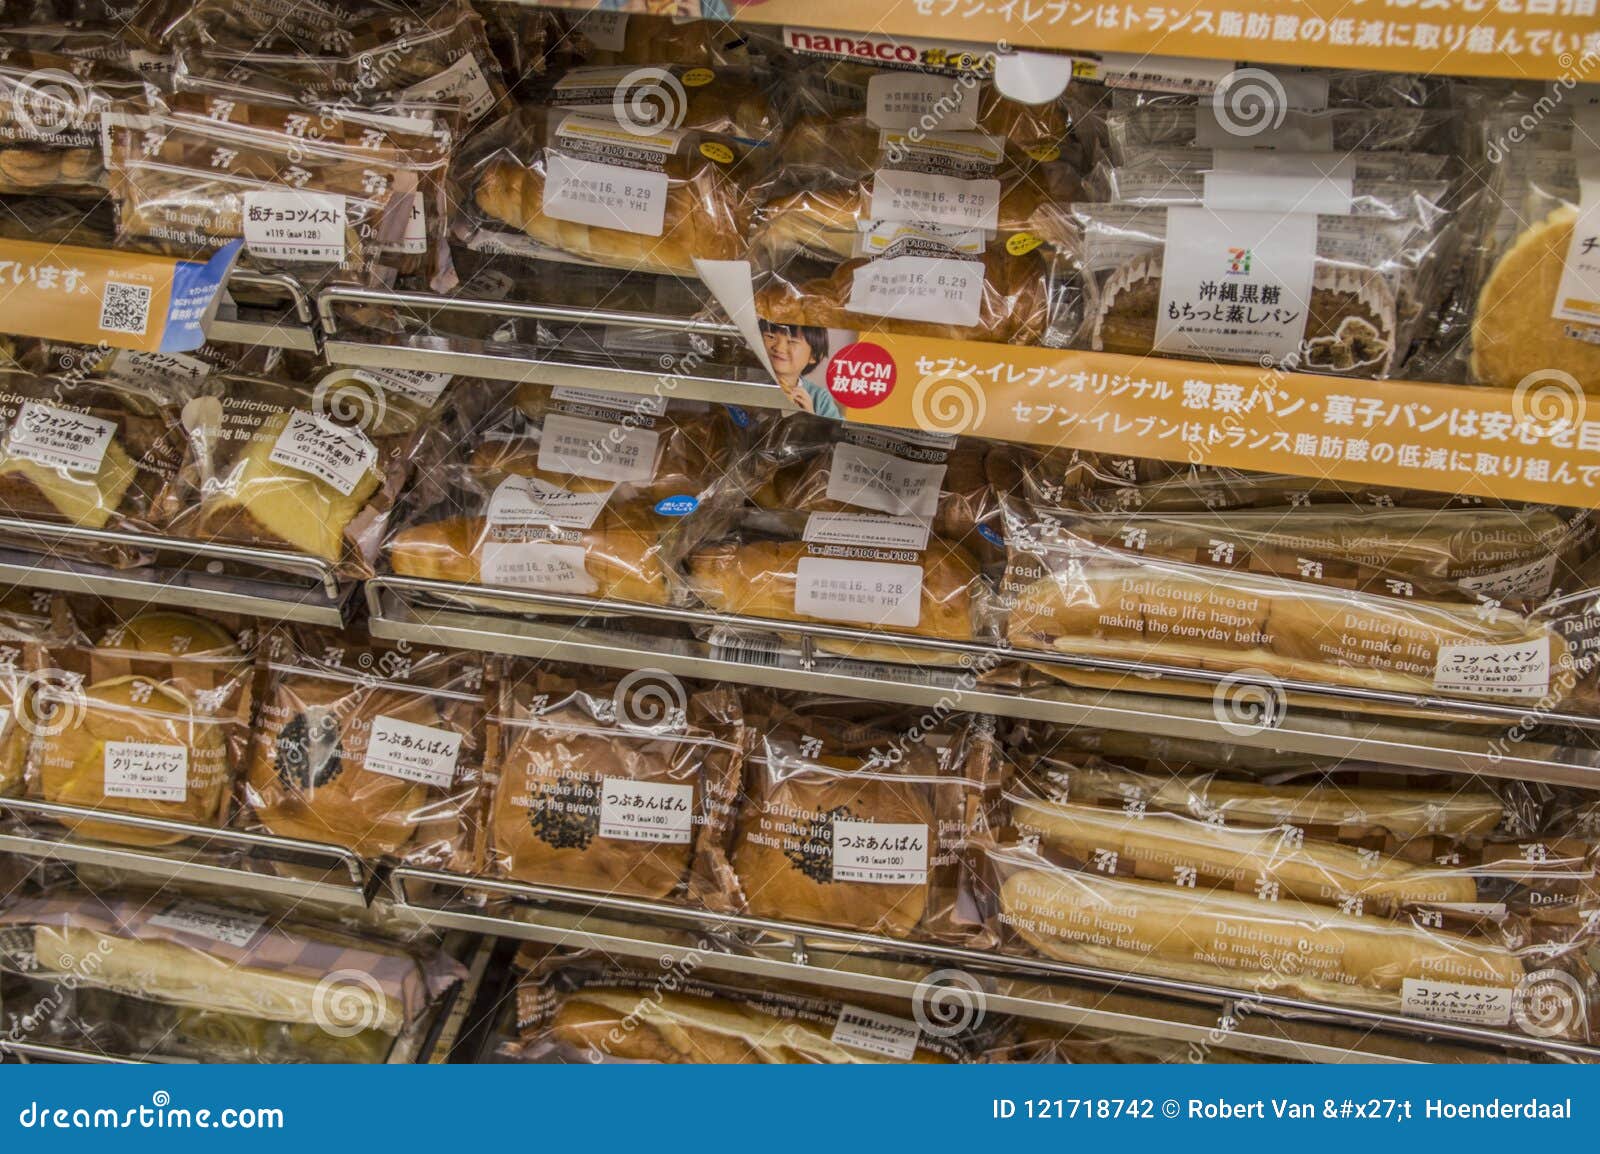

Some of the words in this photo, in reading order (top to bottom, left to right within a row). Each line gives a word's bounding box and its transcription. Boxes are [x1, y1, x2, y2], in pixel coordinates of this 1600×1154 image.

[791, 32, 918, 63] nanaco
[248, 205, 340, 224] 板チョコツイスト
[1199, 281, 1281, 304] 沖縄黒糖
[1168, 301, 1300, 324] もちっと蒸しパン
[834, 358, 891, 379] TVCM
[915, 356, 1173, 400] セブン-イレブンオリジナル
[831, 375, 888, 396] 放映中
[223, 397, 284, 415] Delicious
[1122, 578, 1202, 603] Delicious
[1208, 592, 1258, 611] bread
[1120, 599, 1134, 611] to
[1139, 602, 1177, 617] make
[1182, 604, 1206, 620] life
[1210, 610, 1255, 628] happy
[1099, 613, 1144, 632] making
[1148, 618, 1168, 633] the
[1172, 622, 1231, 643] everyday
[1235, 628, 1274, 645] better
[1344, 614, 1429, 642] Delicious
[1320, 641, 1365, 662] making
[1370, 652, 1392, 668] the
[1341, 633, 1357, 646] to
[1361, 636, 1402, 652] make
[1407, 642, 1431, 659] life
[1453, 650, 1538, 664] コッペパン
[376, 731, 454, 757] つぶあんぱん
[113, 758, 178, 773] クリームパン
[526, 763, 590, 781] Delicious
[526, 781, 536, 793] to
[540, 783, 570, 797] make
[607, 794, 687, 811] つぶあんぱん
[760, 818, 772, 829] to
[775, 821, 807, 836] make
[811, 825, 831, 839] life
[747, 832, 780, 849] making
[839, 836, 922, 851] つぶあんぱん
[1015, 899, 1028, 912] to
[1031, 903, 1065, 921] make
[1069, 909, 1090, 925] life
[1094, 914, 1135, 934] happy
[998, 912, 1035, 931] making
[1039, 920, 1057, 936] the
[1059, 926, 1113, 945] everyday
[1116, 936, 1153, 951] better
[1216, 921, 1292, 946] Delicious
[1214, 939, 1227, 950] to
[1231, 942, 1268, 958] make
[1417, 988, 1498, 1003] コッペパン
